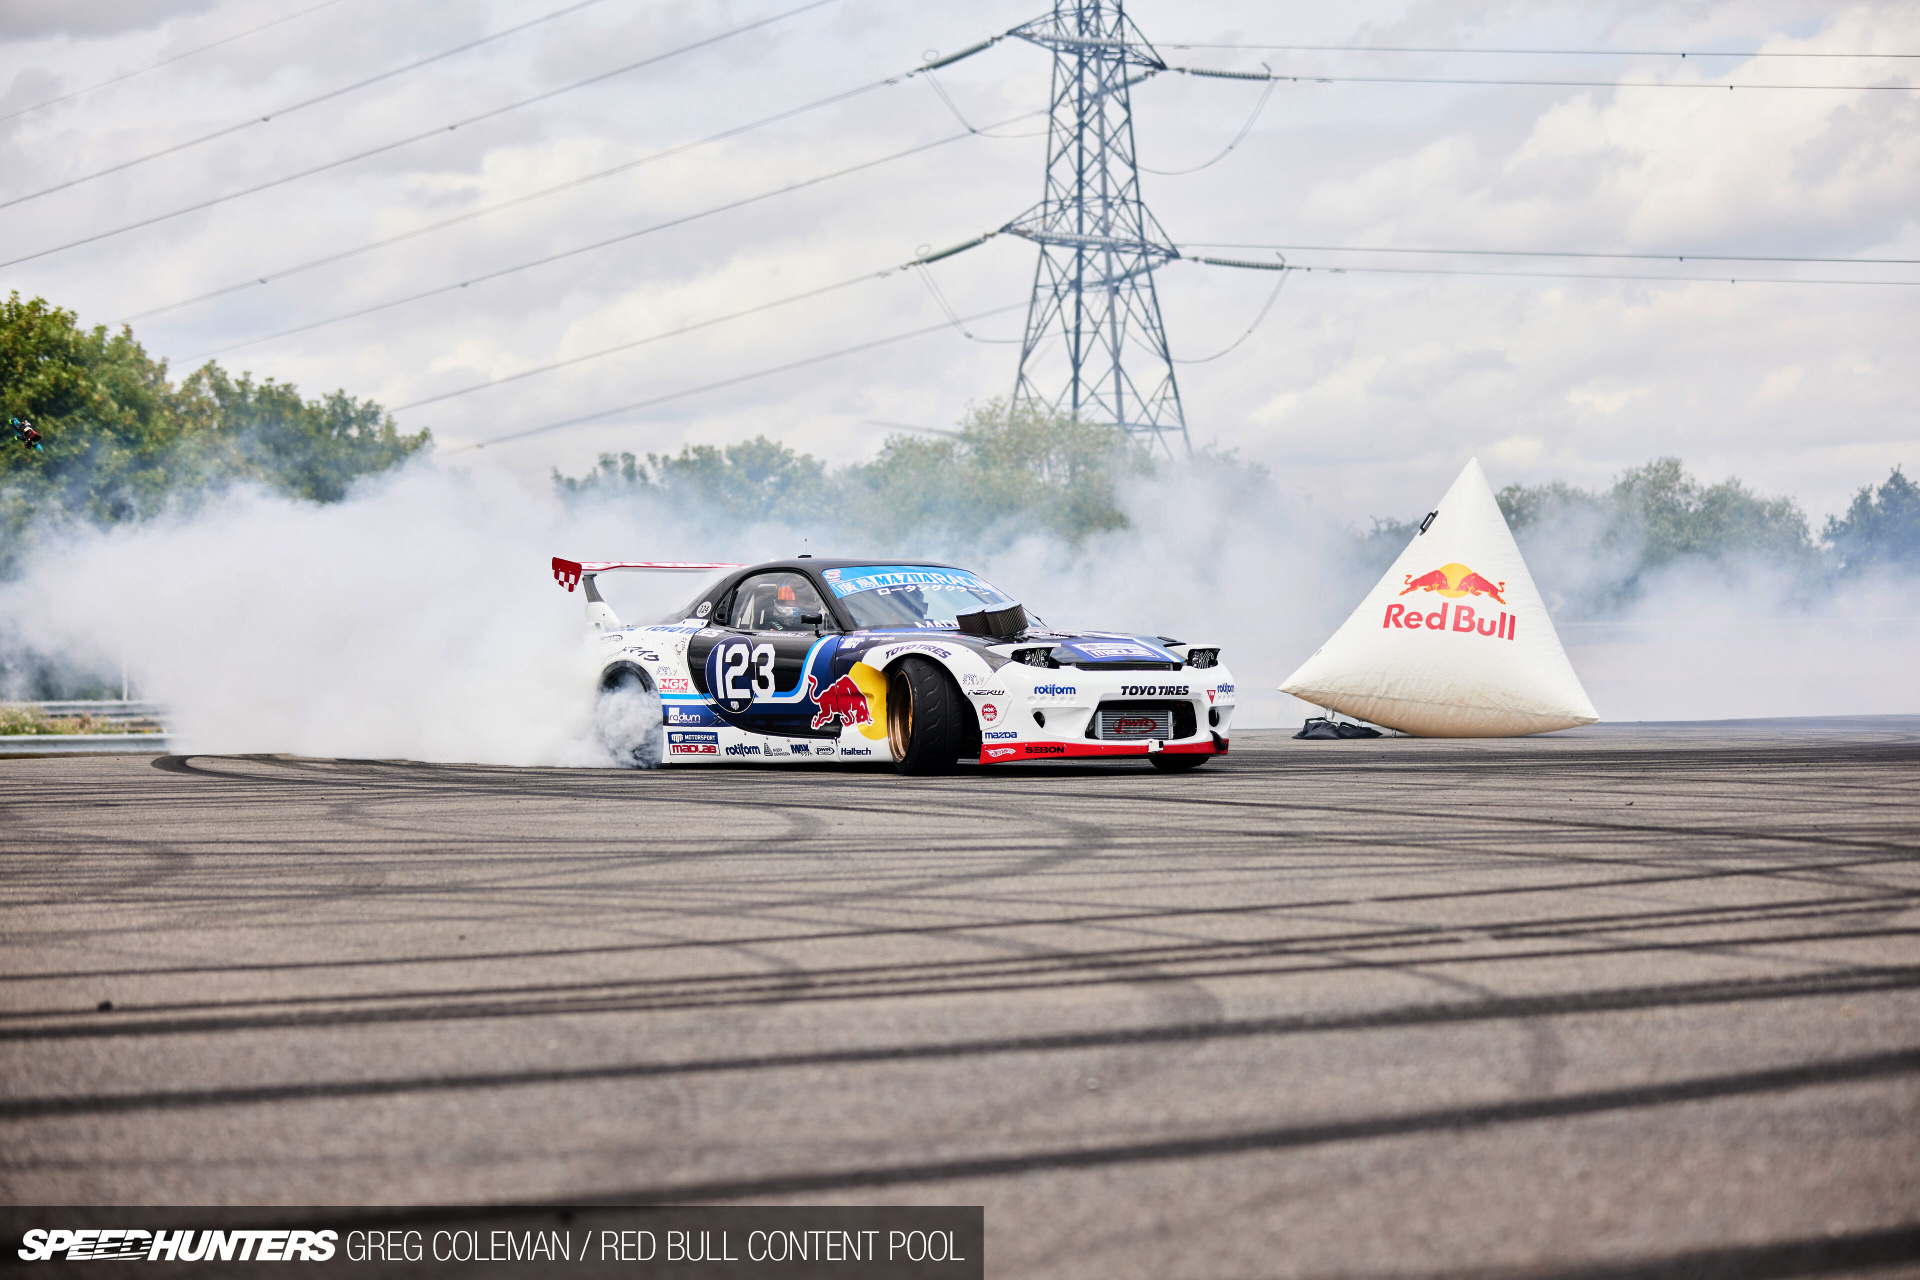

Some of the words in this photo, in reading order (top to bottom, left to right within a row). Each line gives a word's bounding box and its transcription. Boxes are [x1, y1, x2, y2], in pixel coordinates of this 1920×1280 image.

[874, 573, 933, 587] MAZDA
[1383, 602, 1449, 631] Red
[1452, 605, 1516, 641] Bull
[885, 645, 917, 659] TOYO
[916, 644, 952, 659] TIRES
[715, 643, 776, 699] 123
[660, 679, 688, 690] NGK
[1034, 684, 1076, 696] rotiform
[1121, 685, 1157, 696] TOYO
[1158, 685, 1189, 696] TIRES
[669, 713, 700, 721] radium
[725, 743, 761, 757] rotiform
[841, 747, 872, 755] Haltech
